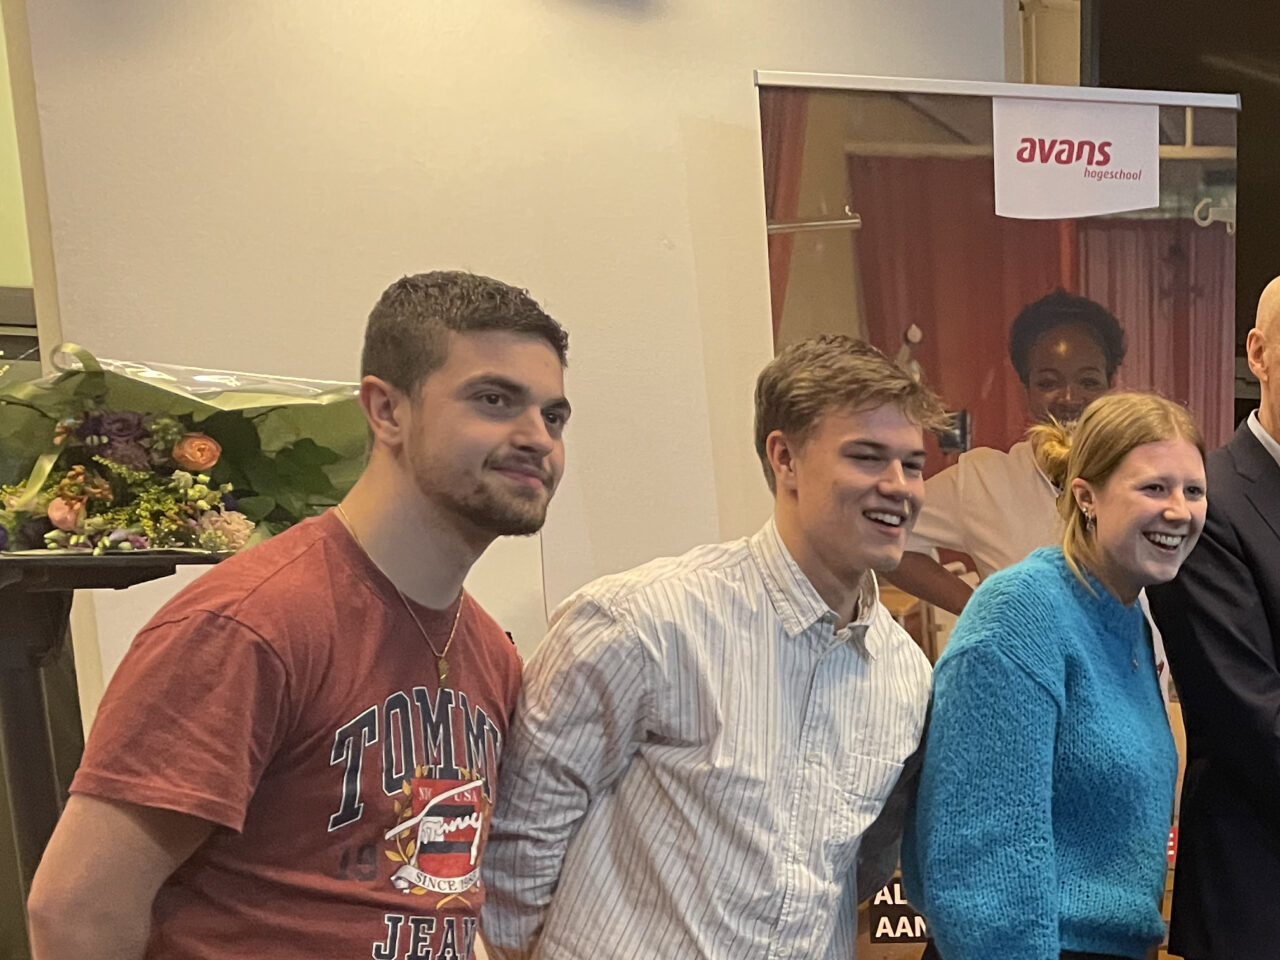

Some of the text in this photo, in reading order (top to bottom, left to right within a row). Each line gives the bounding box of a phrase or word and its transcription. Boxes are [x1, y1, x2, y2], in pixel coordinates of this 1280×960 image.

[1016, 137, 1113, 166] avans
[1083, 167, 1143, 182] hogeschool
[453, 789, 478, 802] USA
[414, 870, 458, 893] SINCE
